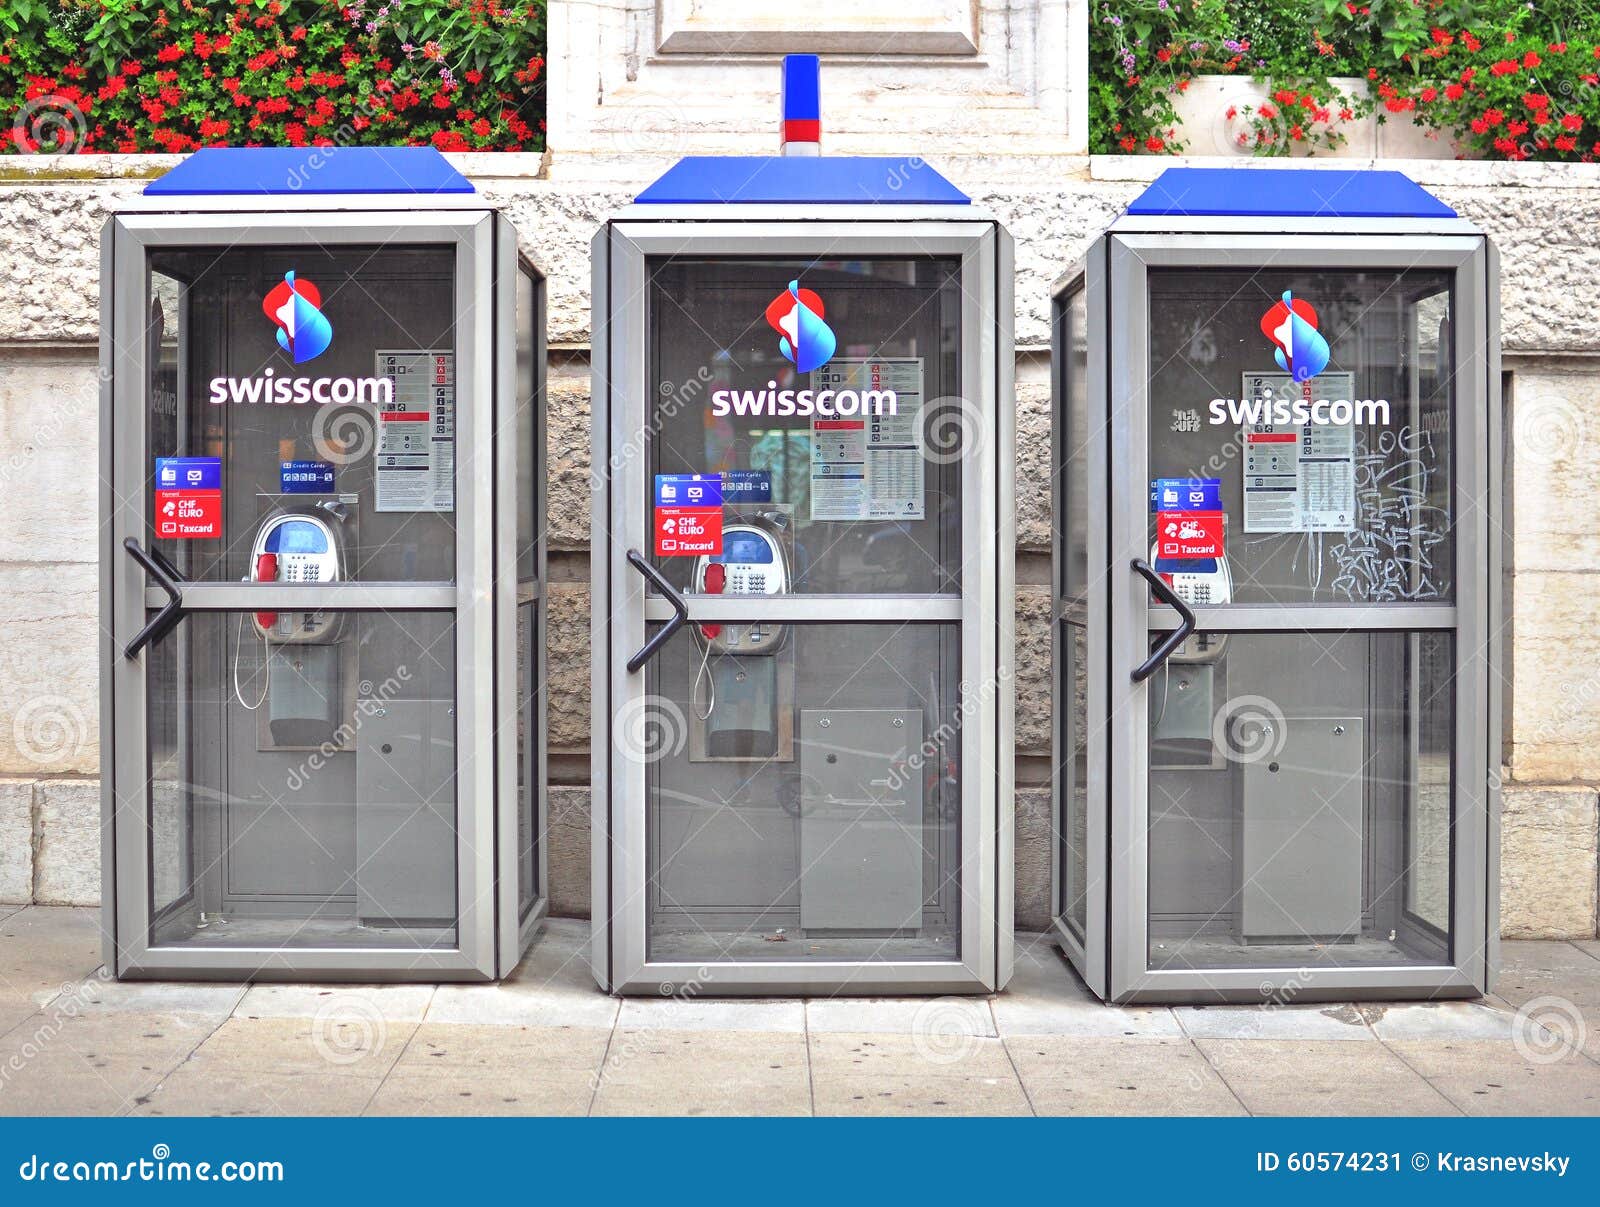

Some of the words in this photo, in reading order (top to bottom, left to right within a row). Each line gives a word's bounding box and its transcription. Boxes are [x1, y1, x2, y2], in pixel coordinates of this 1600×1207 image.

[209, 367, 393, 404] swisscom
[712, 380, 898, 418] swisscom
[1208, 388, 1391, 426] swisscom
[178, 500, 196, 508] CHF
[178, 508, 204, 518] EURO
[678, 517, 697, 525] CHF
[1180, 521, 1199, 530] CHF
[179, 523, 213, 533] Taxcard
[678, 526, 704, 535] EURO
[679, 541, 714, 551] Taxcard
[1181, 545, 1215, 554] Taxcard
